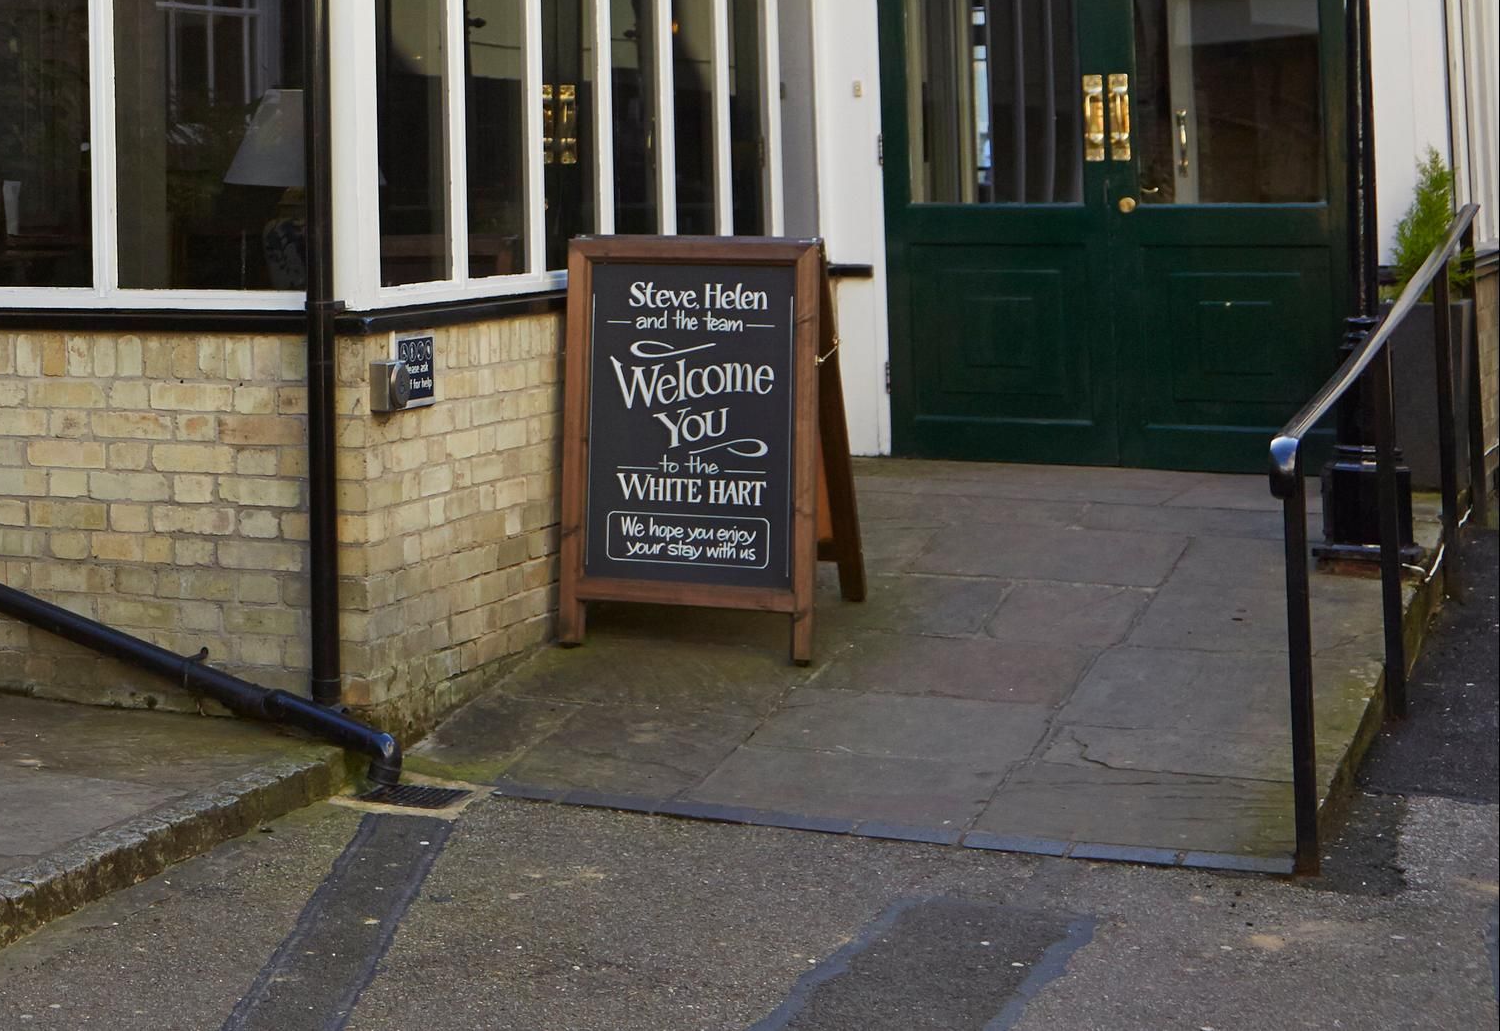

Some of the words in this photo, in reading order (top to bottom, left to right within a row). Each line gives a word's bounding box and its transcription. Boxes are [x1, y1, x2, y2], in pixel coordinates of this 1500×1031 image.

[628, 281, 700, 310] Steve,
[704, 282, 768, 310] Helen
[636, 310, 668, 329] and
[671, 310, 698, 331] the
[702, 311, 744, 332] team
[420, 362, 429, 373] ask
[413, 378, 421, 390] for
[421, 377, 433, 391] help
[609, 355, 774, 409] Welcome
[658, 454, 680, 474] to
[684, 455, 720, 475] the
[616, 473, 703, 504] WHITE
[708, 479, 767, 507] HART
[620, 516, 646, 537] We
[649, 517, 684, 541] hope
[686, 527, 714, 543] you
[716, 525, 757, 547] enjoy
[626, 541, 666, 557] your
[667, 540, 703, 561] stay
[706, 542, 737, 560] with
[740, 548, 757, 561] us
